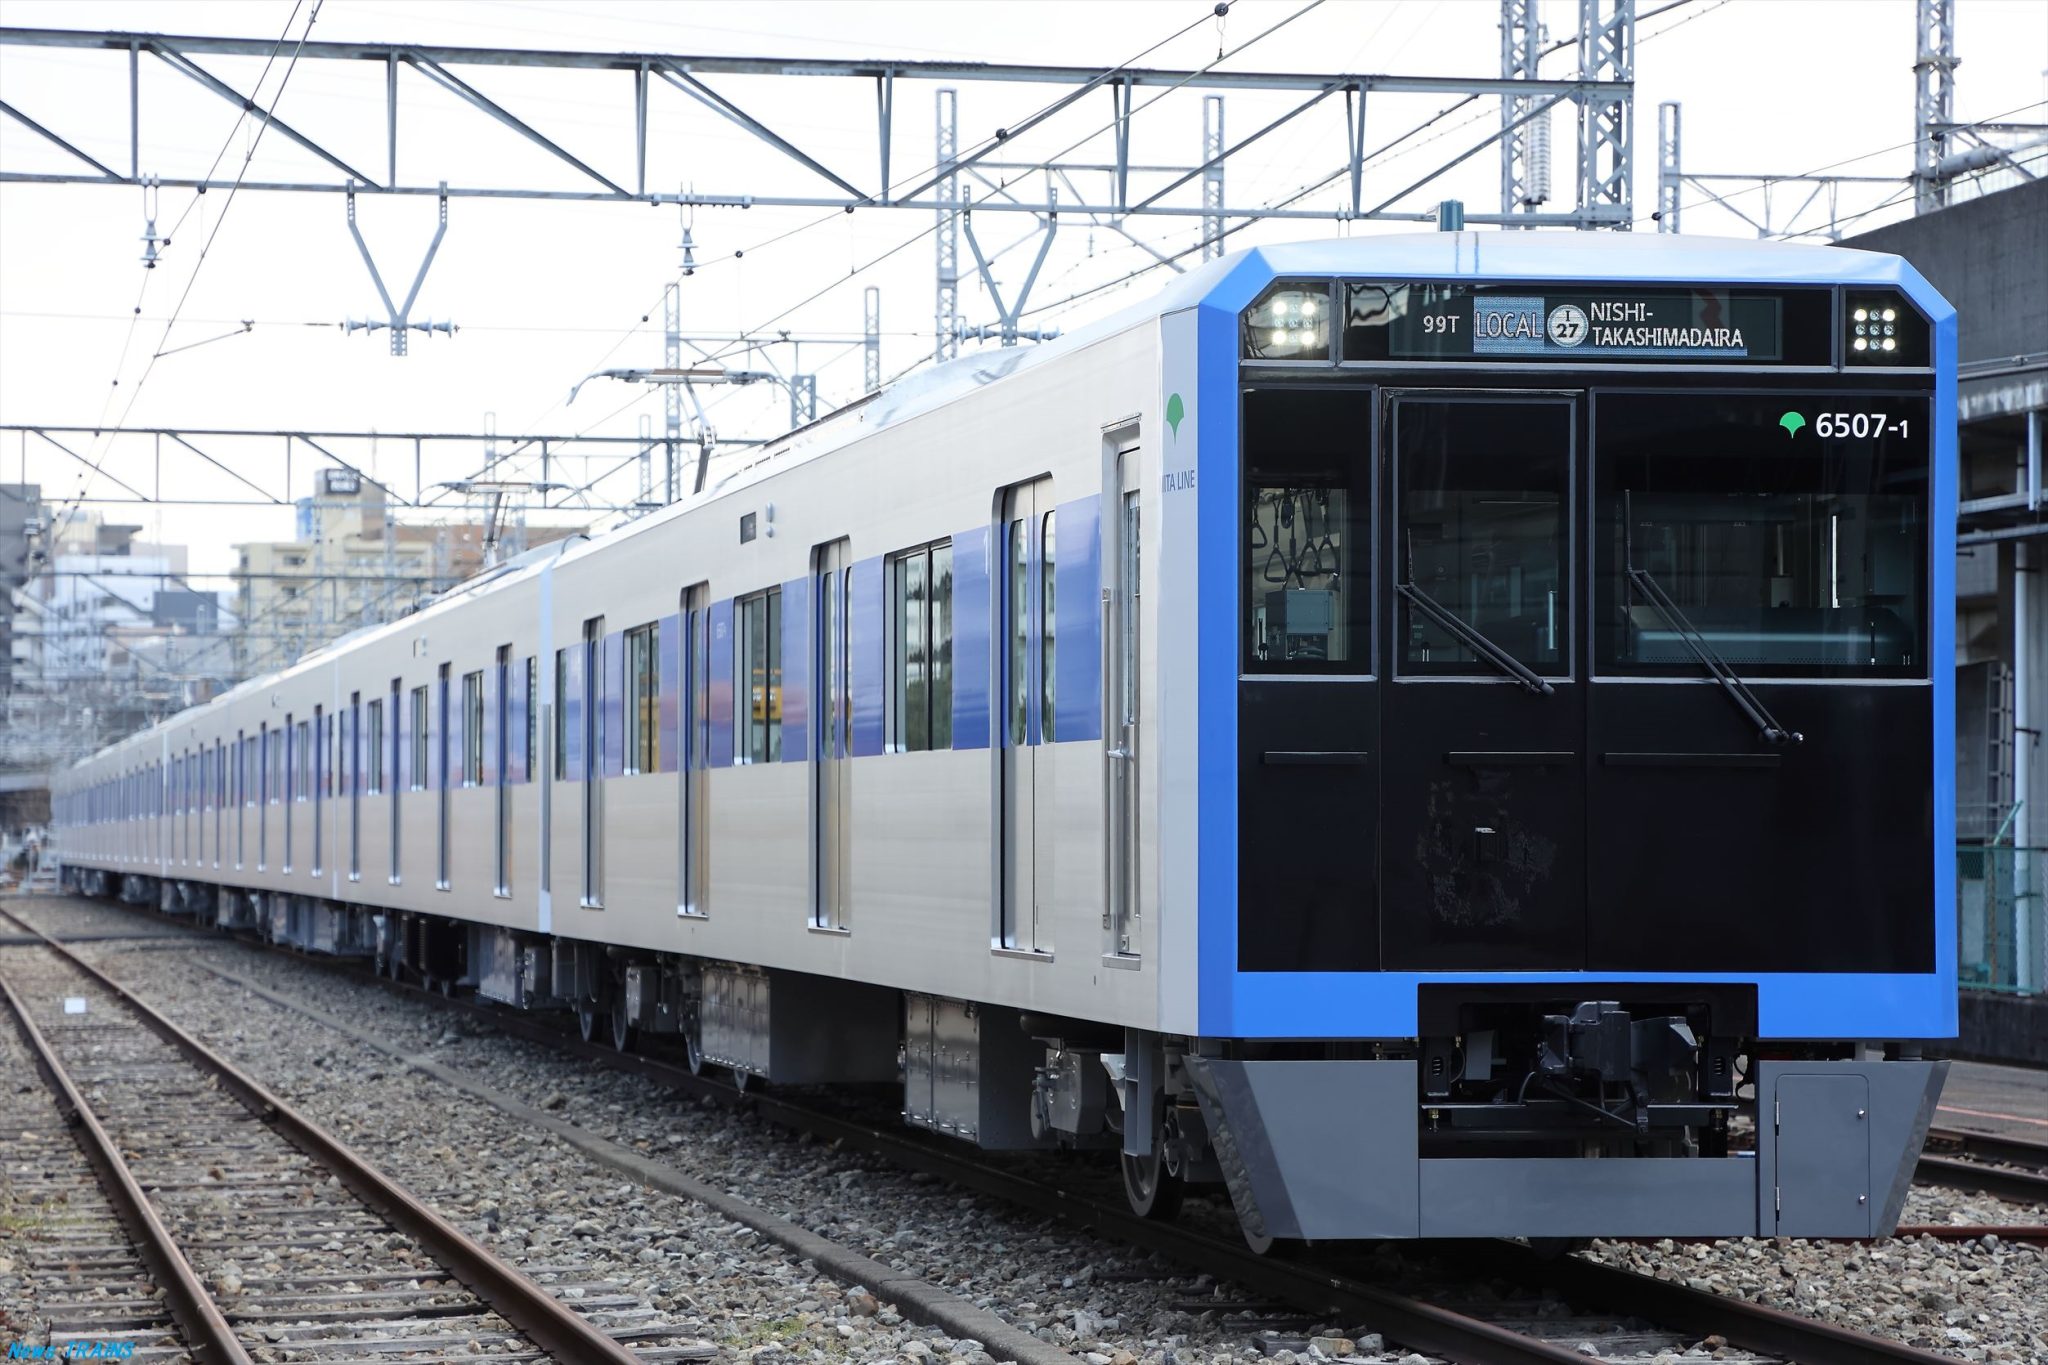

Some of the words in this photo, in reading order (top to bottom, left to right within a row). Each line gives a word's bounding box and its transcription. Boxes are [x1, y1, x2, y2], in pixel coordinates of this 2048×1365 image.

[1565, 310, 1571, 322] I
[1590, 302, 1653, 322] NISHI-
[1423, 314, 1460, 334] 99T
[1475, 312, 1543, 338] LOCAL
[1556, 323, 1579, 338] 27
[1592, 327, 1744, 347] TAKASHIMADAIRA
[1815, 413, 1908, 439] 6507-1
[1177, 469, 1195, 490] LINE
